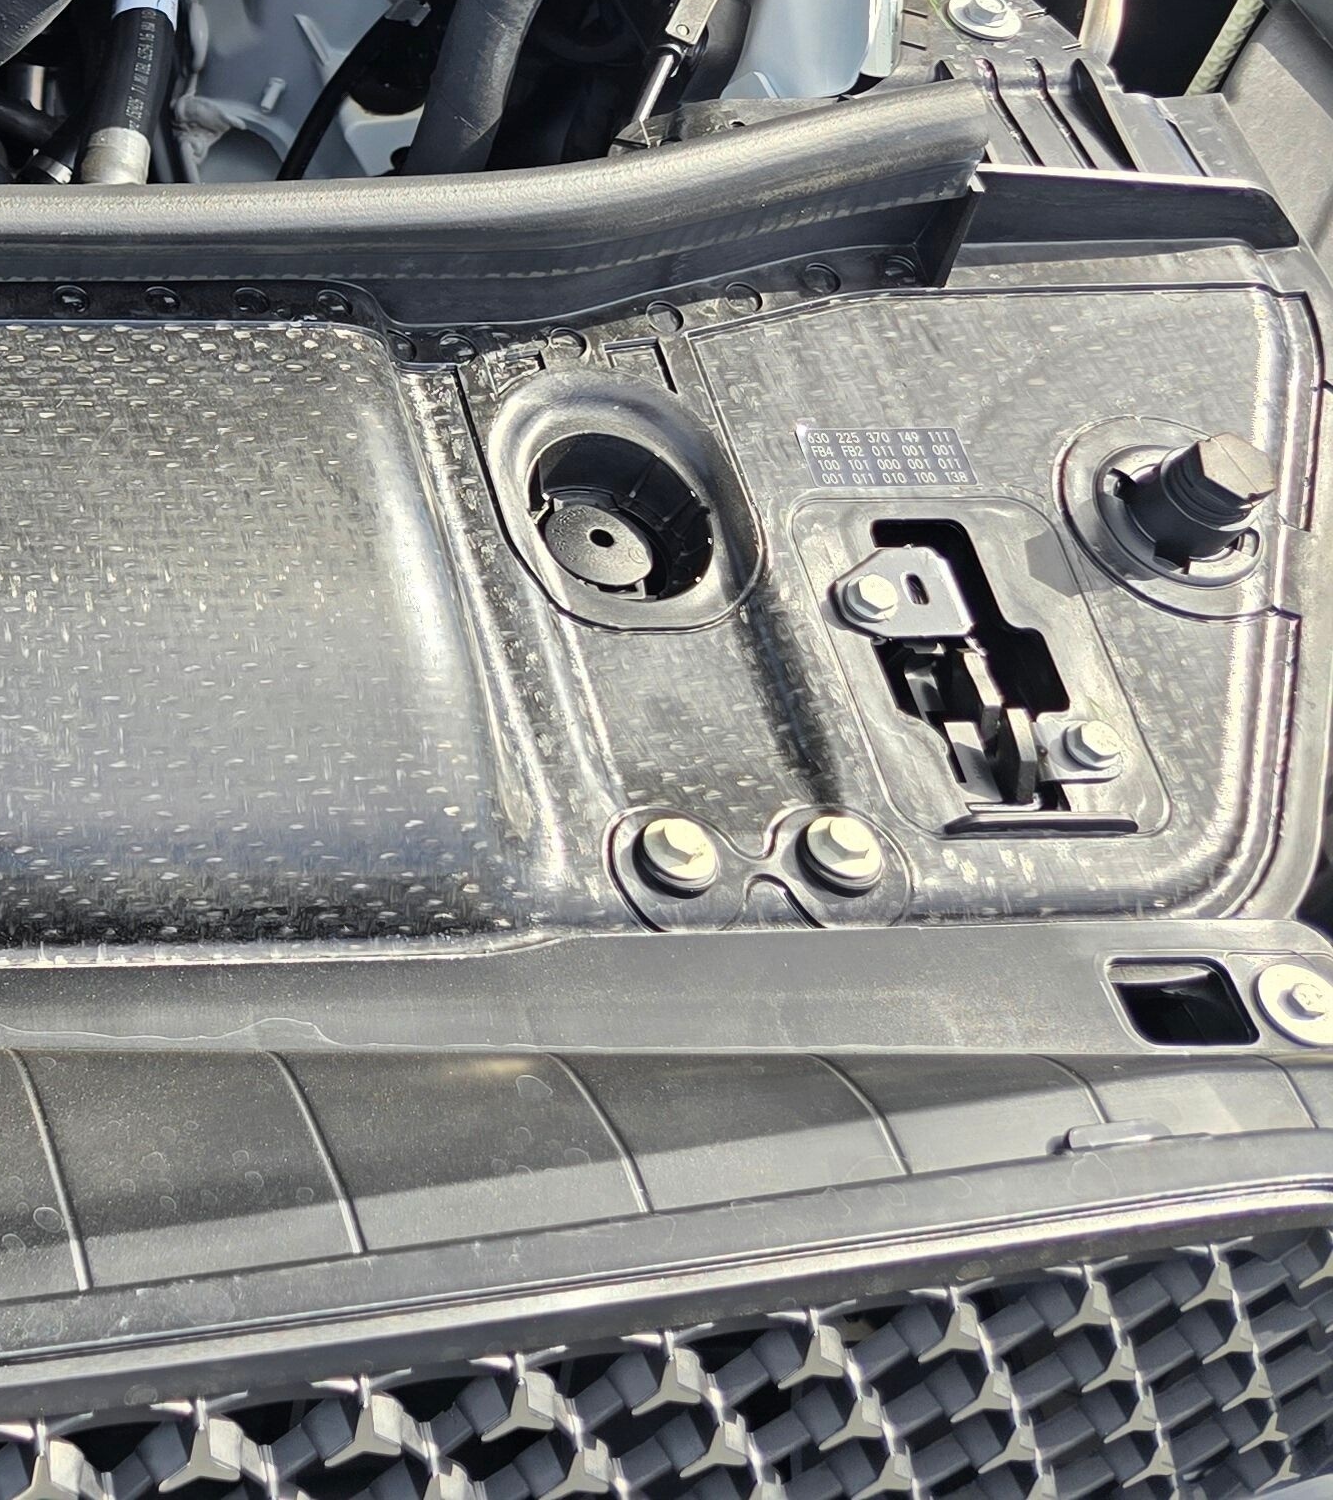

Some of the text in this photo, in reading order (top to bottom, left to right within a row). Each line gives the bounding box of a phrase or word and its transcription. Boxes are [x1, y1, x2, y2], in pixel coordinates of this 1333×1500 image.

[807, 431, 951, 443] 630 225 370 149 111
[811, 445, 956, 457] FB4 FB2 011 001 001
[818, 458, 961, 471] 100 101 000 001 011
[822, 472, 969, 485] 001 011 010 100 138
